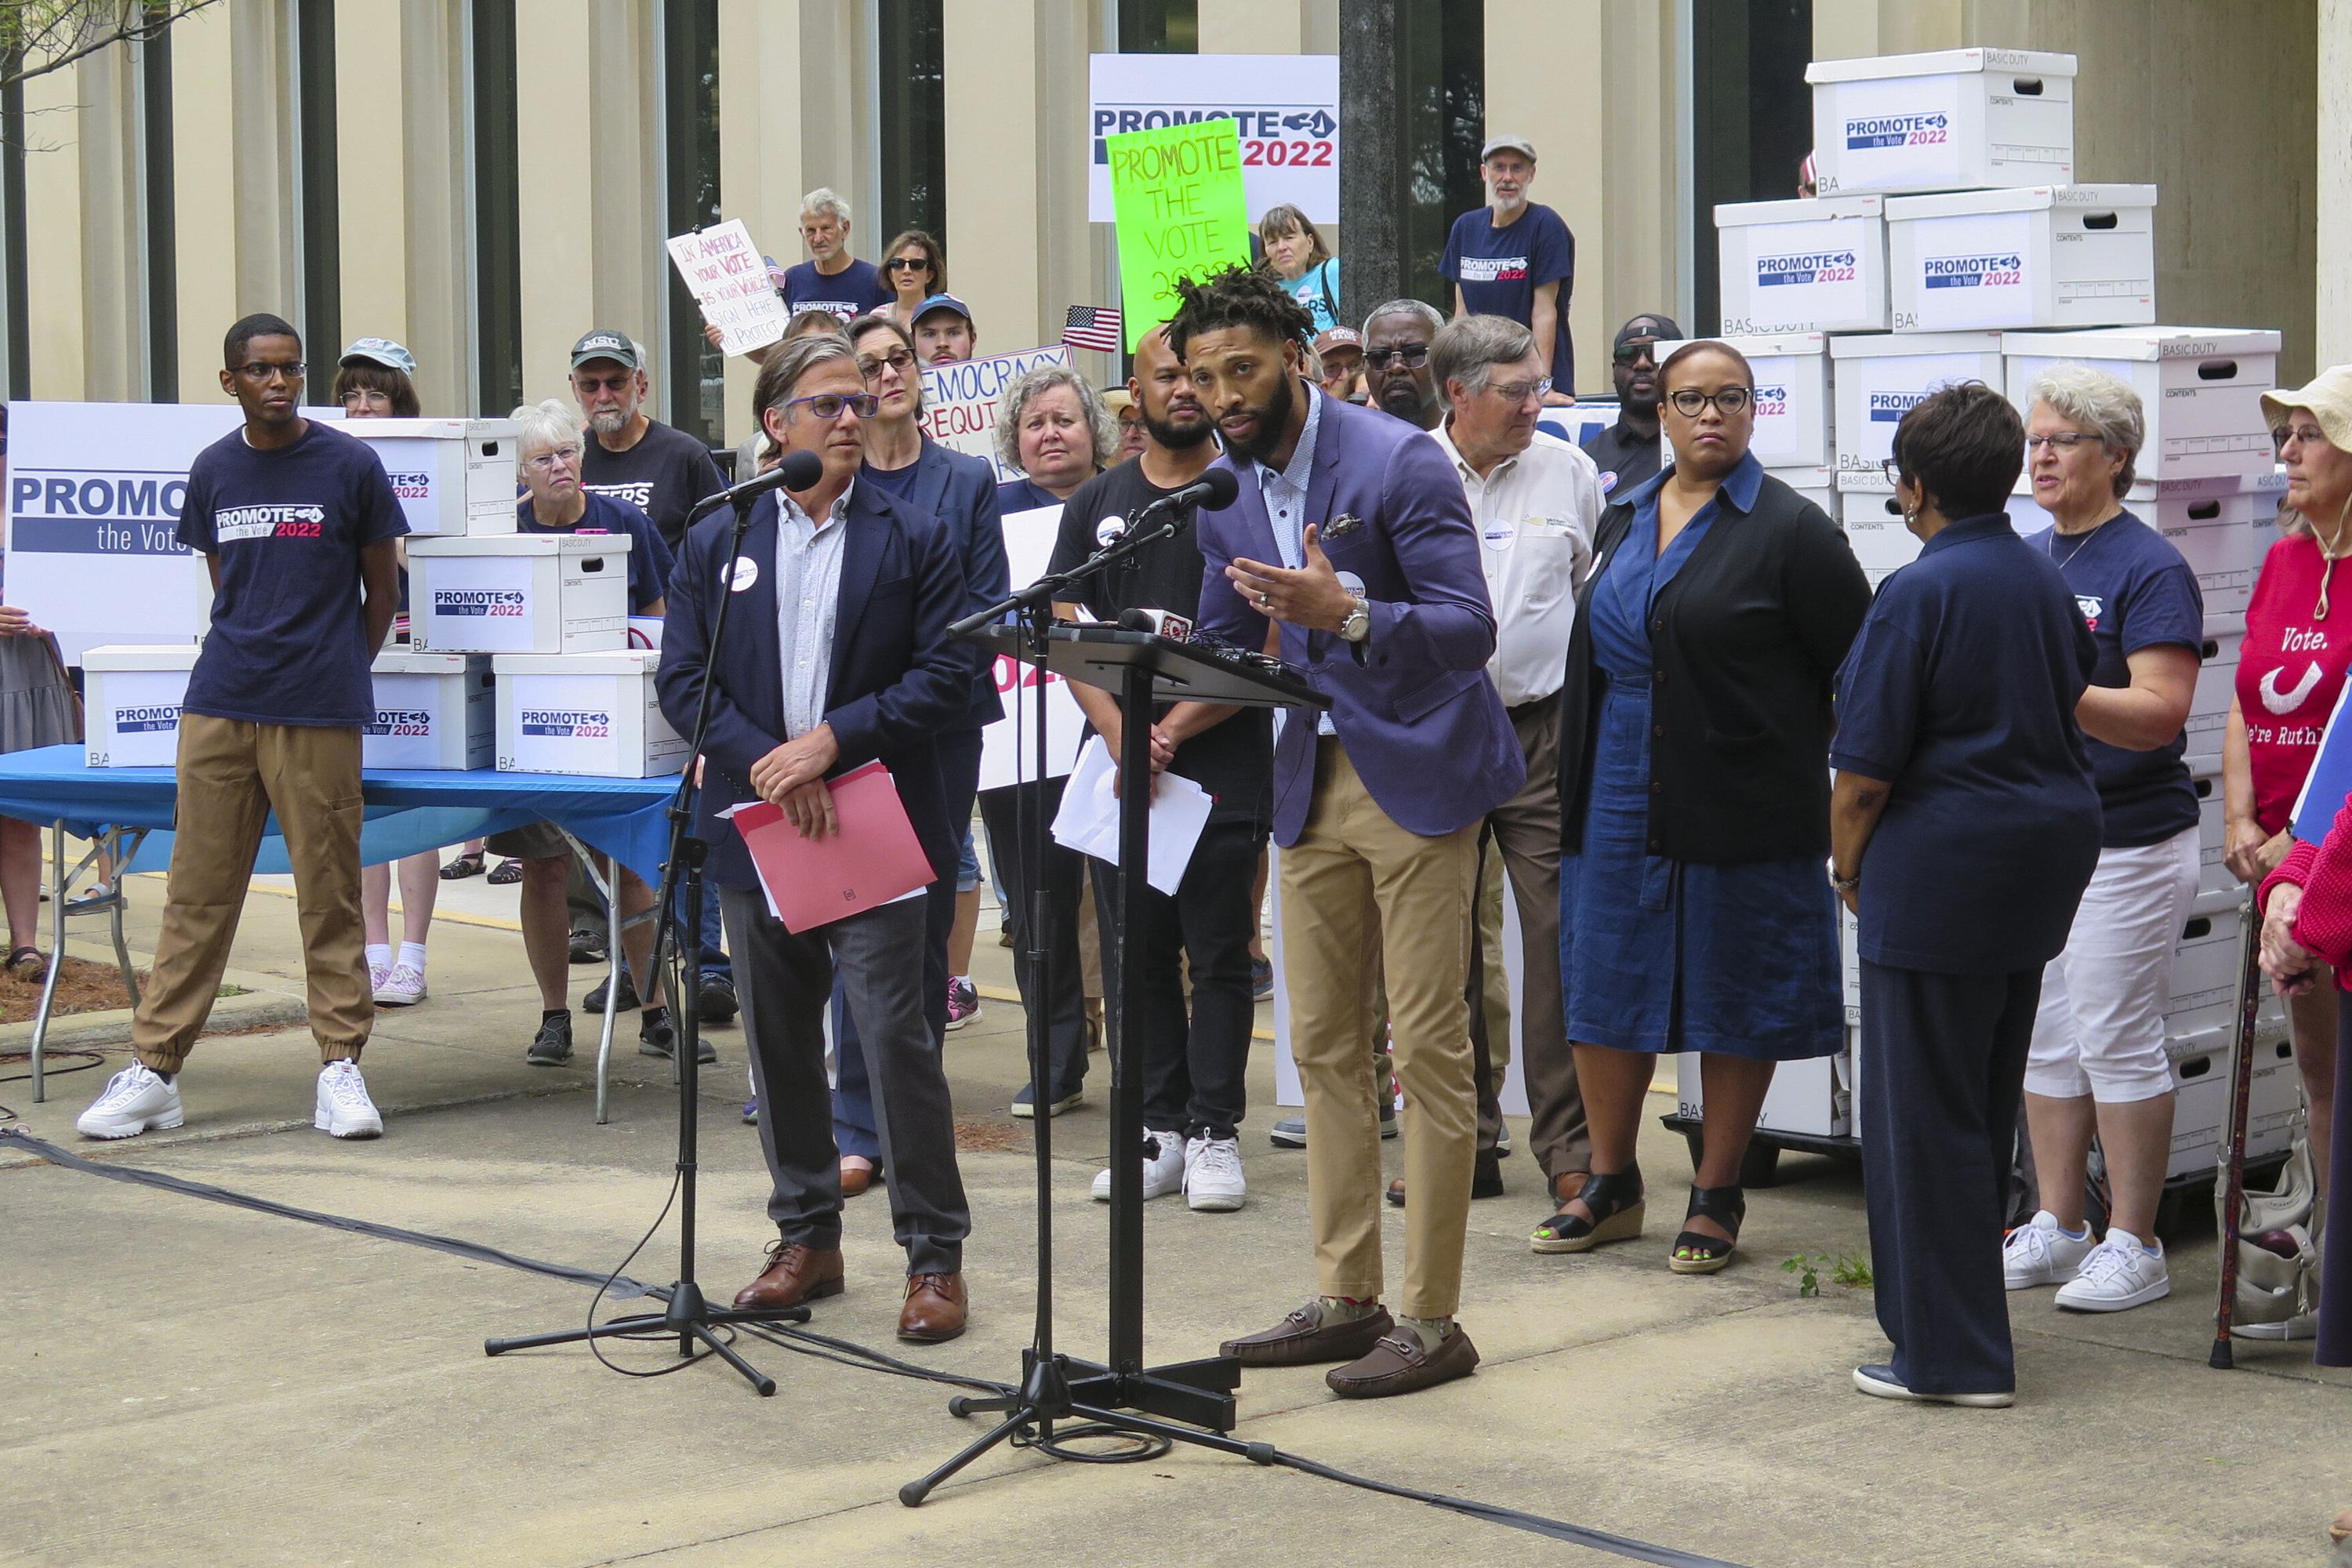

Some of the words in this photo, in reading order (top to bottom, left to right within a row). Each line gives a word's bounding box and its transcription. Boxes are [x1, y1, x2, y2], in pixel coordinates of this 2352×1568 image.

[1987, 52, 2009, 64] BASIC
[2009, 54, 2029, 65] DUTY
[1094, 110, 1279, 137] PROMTE
[1846, 117, 1924, 136] PROMOTE
[1873, 136, 1885, 147] the
[1886, 135, 1903, 146] Vote
[1908, 129, 1947, 145] 2022
[1112, 135, 1236, 185] PROMOTE
[1243, 140, 1332, 166] 2022
[1145, 183, 1204, 220] THE
[2058, 191, 2078, 202] BASIC
[2079, 191, 2100, 202] DUTY
[699, 231, 746, 260] AMERICA
[1144, 219, 1224, 260] VOTE
[718, 251, 754, 275] VOTE
[1461, 260, 1509, 270] PROMOTE
[1758, 255, 1833, 273] PROMOTE
[1925, 257, 1999, 274] PROMOTE
[1497, 270, 1527, 280] 2022
[1784, 274, 1795, 284] the
[1796, 272, 1813, 282] Vote
[1817, 267, 1856, 282] 2022
[1950, 277, 1962, 286] the
[1962, 275, 1979, 286] Vote
[1984, 271, 2021, 287] 2022
[744, 298, 775, 320] HERE
[793, 303, 843, 312] PROMOTE
[734, 319, 782, 347] PROTECT
[2163, 344, 2191, 356] BASIC
[2193, 343, 2218, 354] DUTY
[1871, 394, 1926, 408] PROMO
[1754, 402, 1785, 416] 022
[917, 401, 997, 440] REQUI
[1841, 476, 1868, 485] BASIC
[2257, 476, 2274, 487] ASIC
[13, 477, 191, 517] PROMO
[394, 487, 428, 498] 2022
[216, 507, 296, 529] PROMOTE
[97, 523, 132, 550] the
[275, 523, 321, 537] 2022
[435, 592, 503, 604] PROMOTE
[458, 605, 469, 615] the
[470, 606, 485, 615] Vote
[489, 604, 524, 616] 2022
[2281, 626, 2328, 652] Vote.
[115, 707, 183, 721] PROMOT
[522, 712, 588, 724] PROMOTE
[158, 721, 173, 730] Vote
[373, 725, 387, 734] Vote
[394, 725, 429, 735] 2022
[545, 727, 555, 735] the
[557, 727, 571, 735] Vote
[575, 725, 608, 738] 2022
